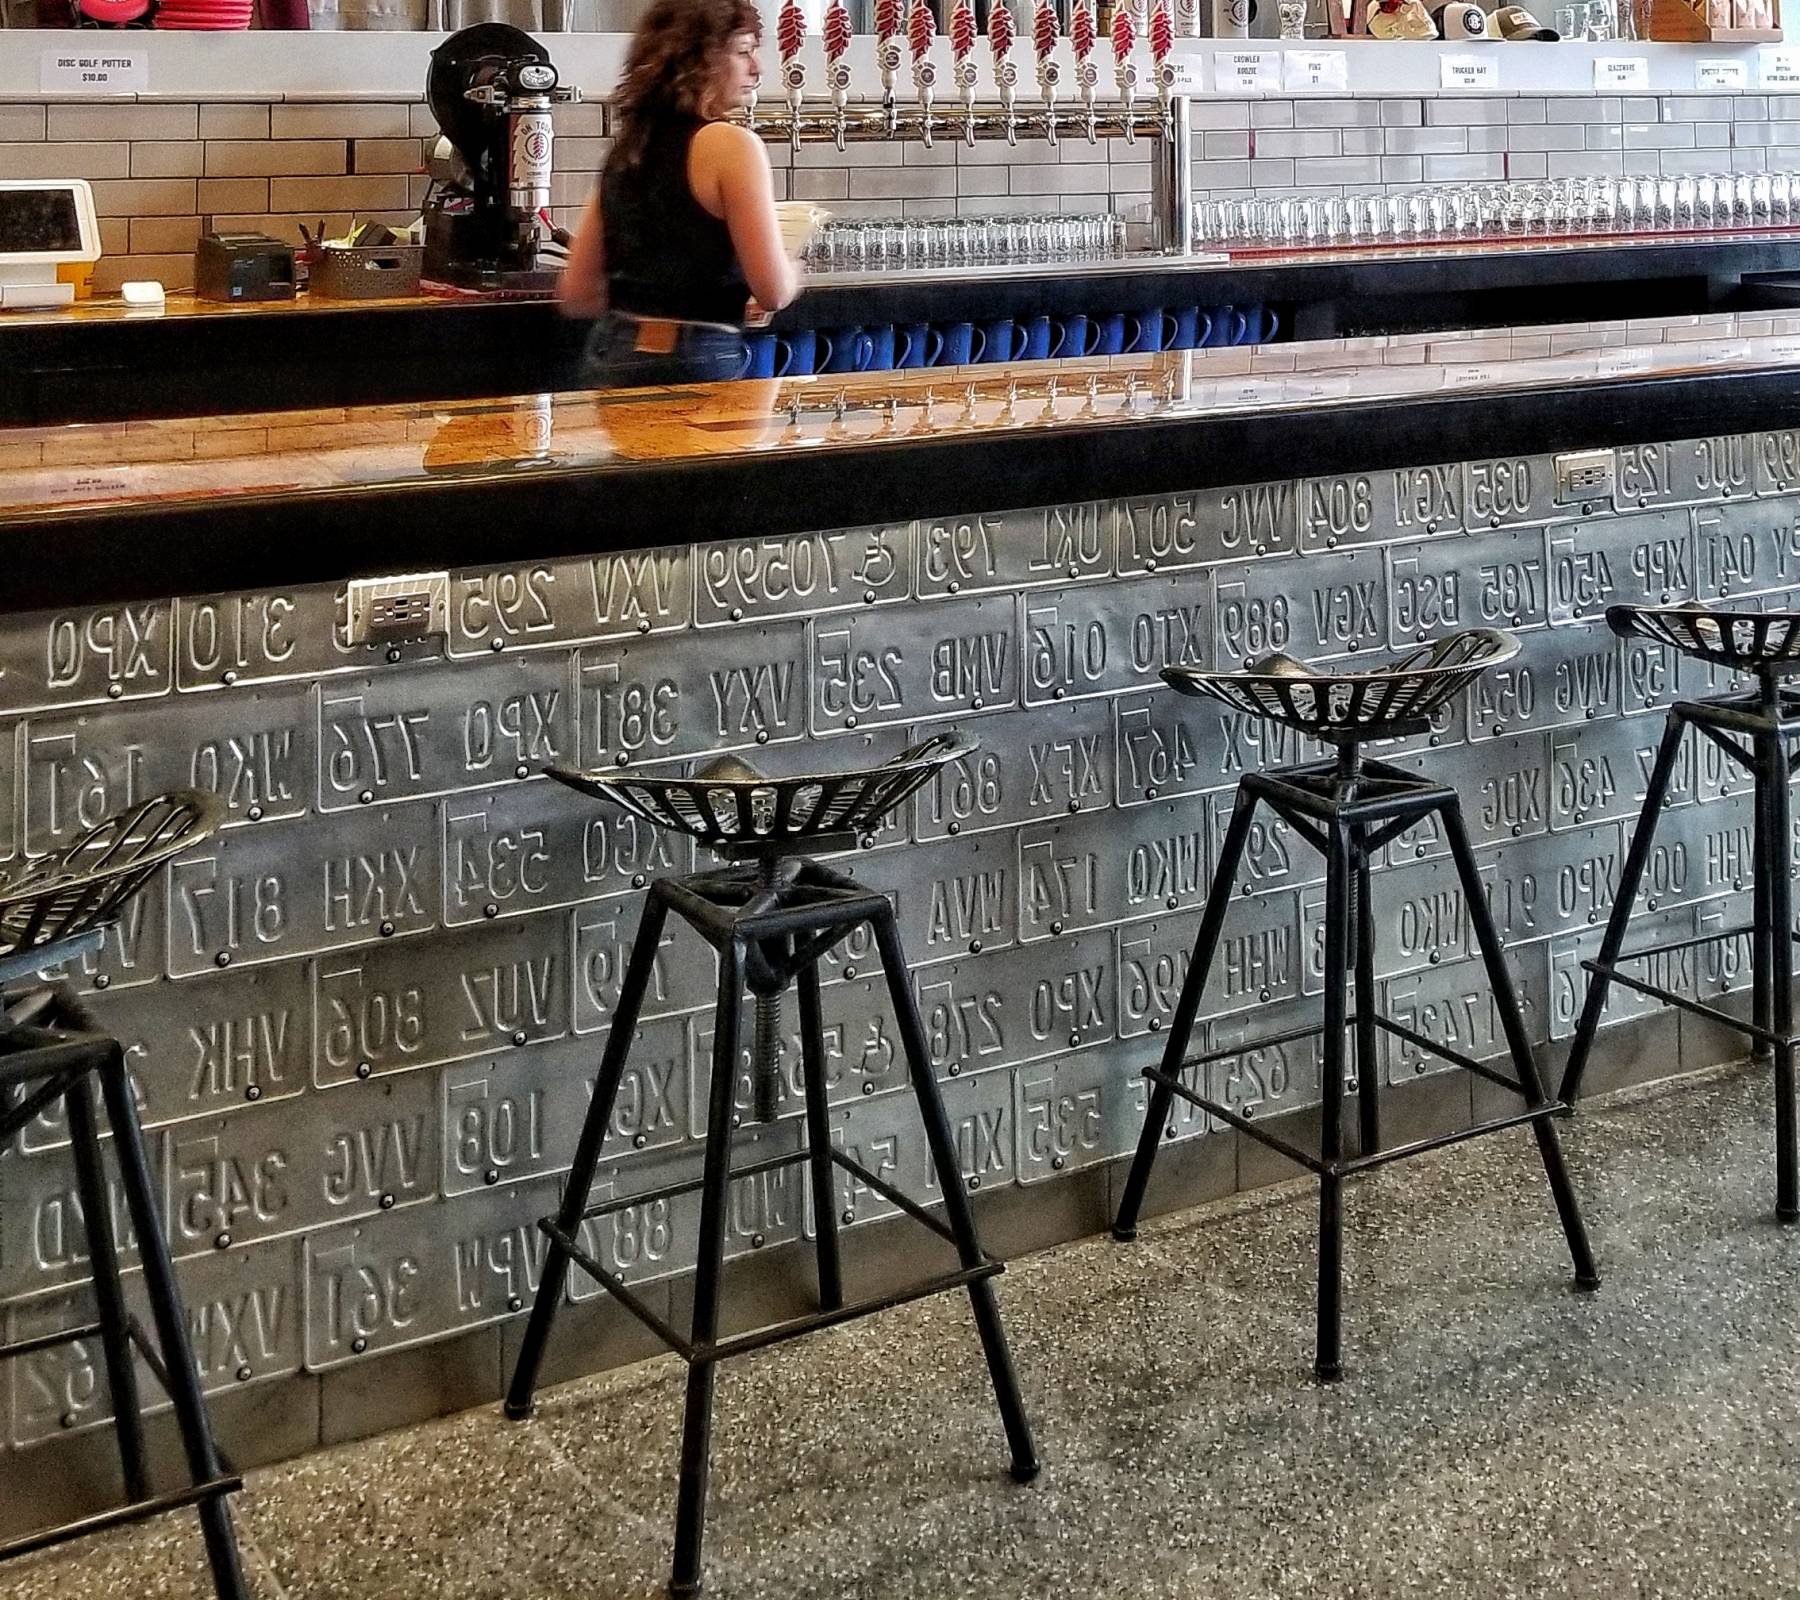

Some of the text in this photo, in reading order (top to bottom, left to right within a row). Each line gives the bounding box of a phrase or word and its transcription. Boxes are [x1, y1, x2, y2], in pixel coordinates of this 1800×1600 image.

[57, 58, 76, 68] DISC
[78, 58, 99, 68] GOLF
[1233, 55, 1260, 64] CROWLER
[1452, 66, 1475, 75] TRUCKER
[520, 123, 534, 137] ON
